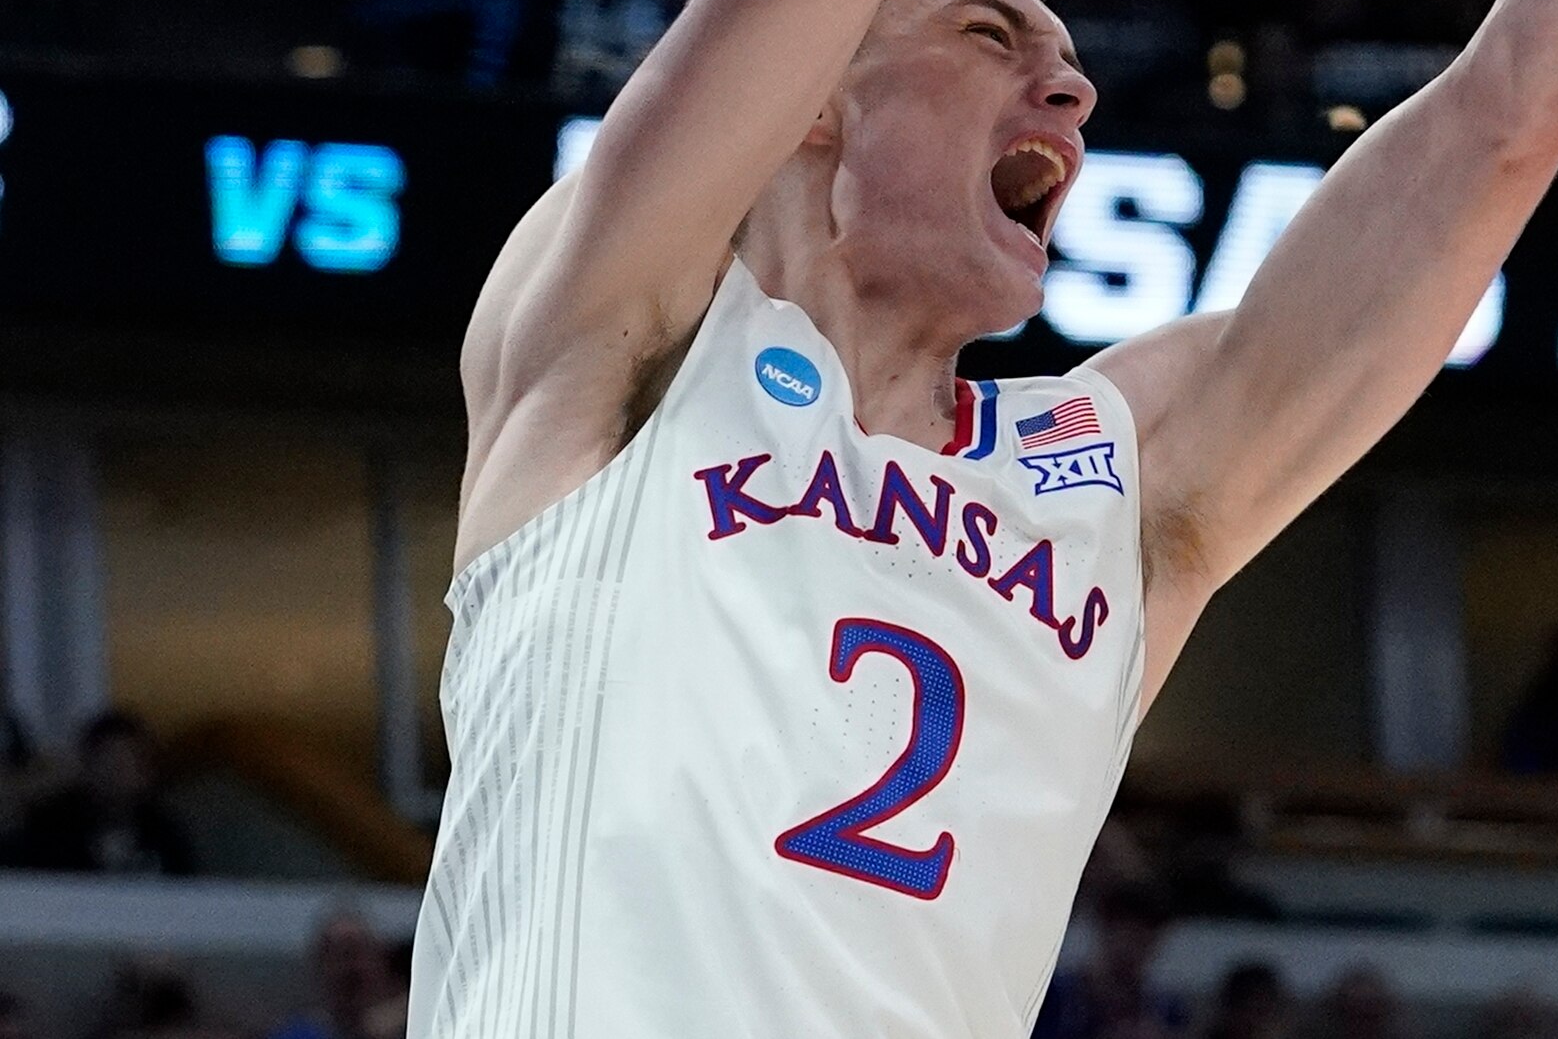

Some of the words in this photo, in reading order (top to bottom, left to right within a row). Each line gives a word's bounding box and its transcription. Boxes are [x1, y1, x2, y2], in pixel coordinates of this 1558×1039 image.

[205, 135, 406, 272] VS
[761, 363, 814, 400] NCAA
[694, 451, 1109, 660] KANSAS
[774, 617, 966, 901] 2
